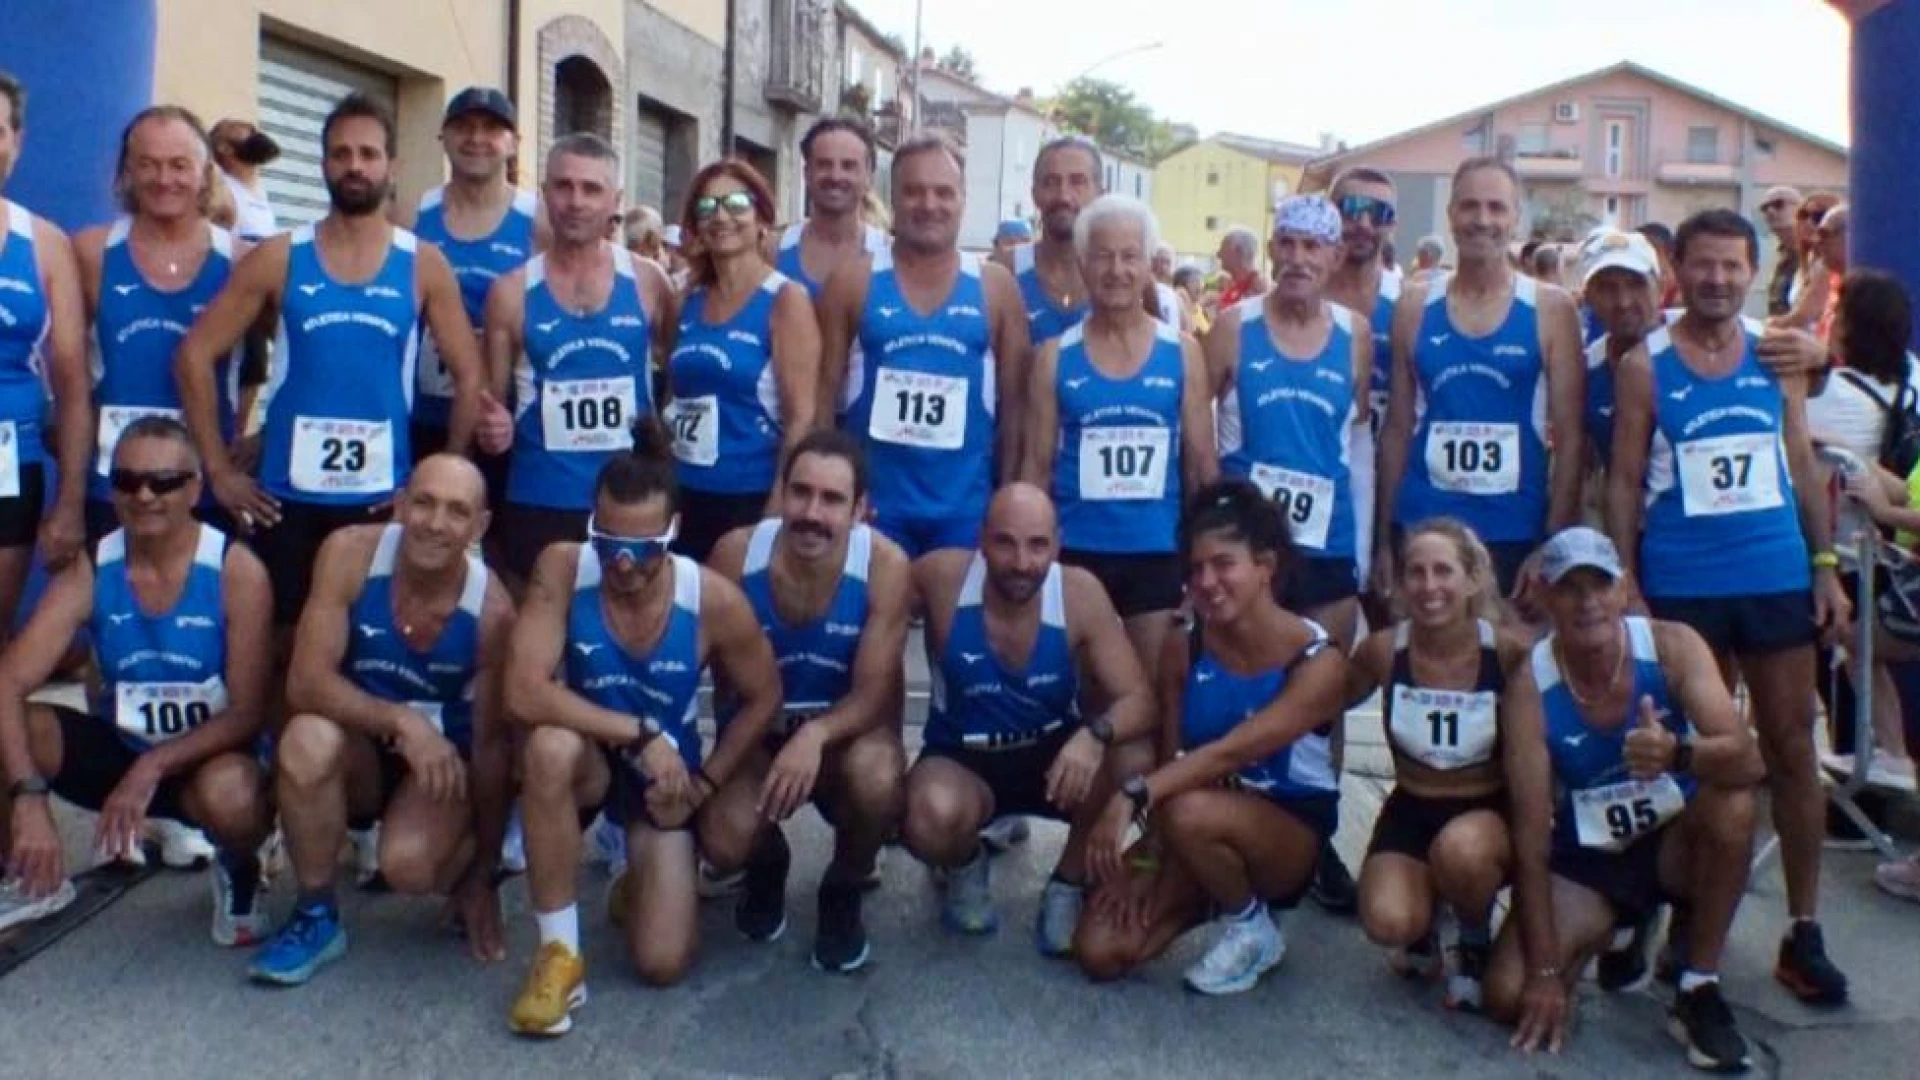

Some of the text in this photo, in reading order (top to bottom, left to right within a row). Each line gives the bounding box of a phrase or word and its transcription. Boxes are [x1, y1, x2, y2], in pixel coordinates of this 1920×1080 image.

[559, 397, 621, 430] 108
[896, 389, 947, 426] 113
[320, 437, 367, 472] 23
[1098, 445, 1155, 478] 107
[1442, 440, 1502, 473] 103
[1711, 453, 1752, 491] 37
[1427, 710, 1458, 747] 11
[1605, 799, 1658, 841] 95
